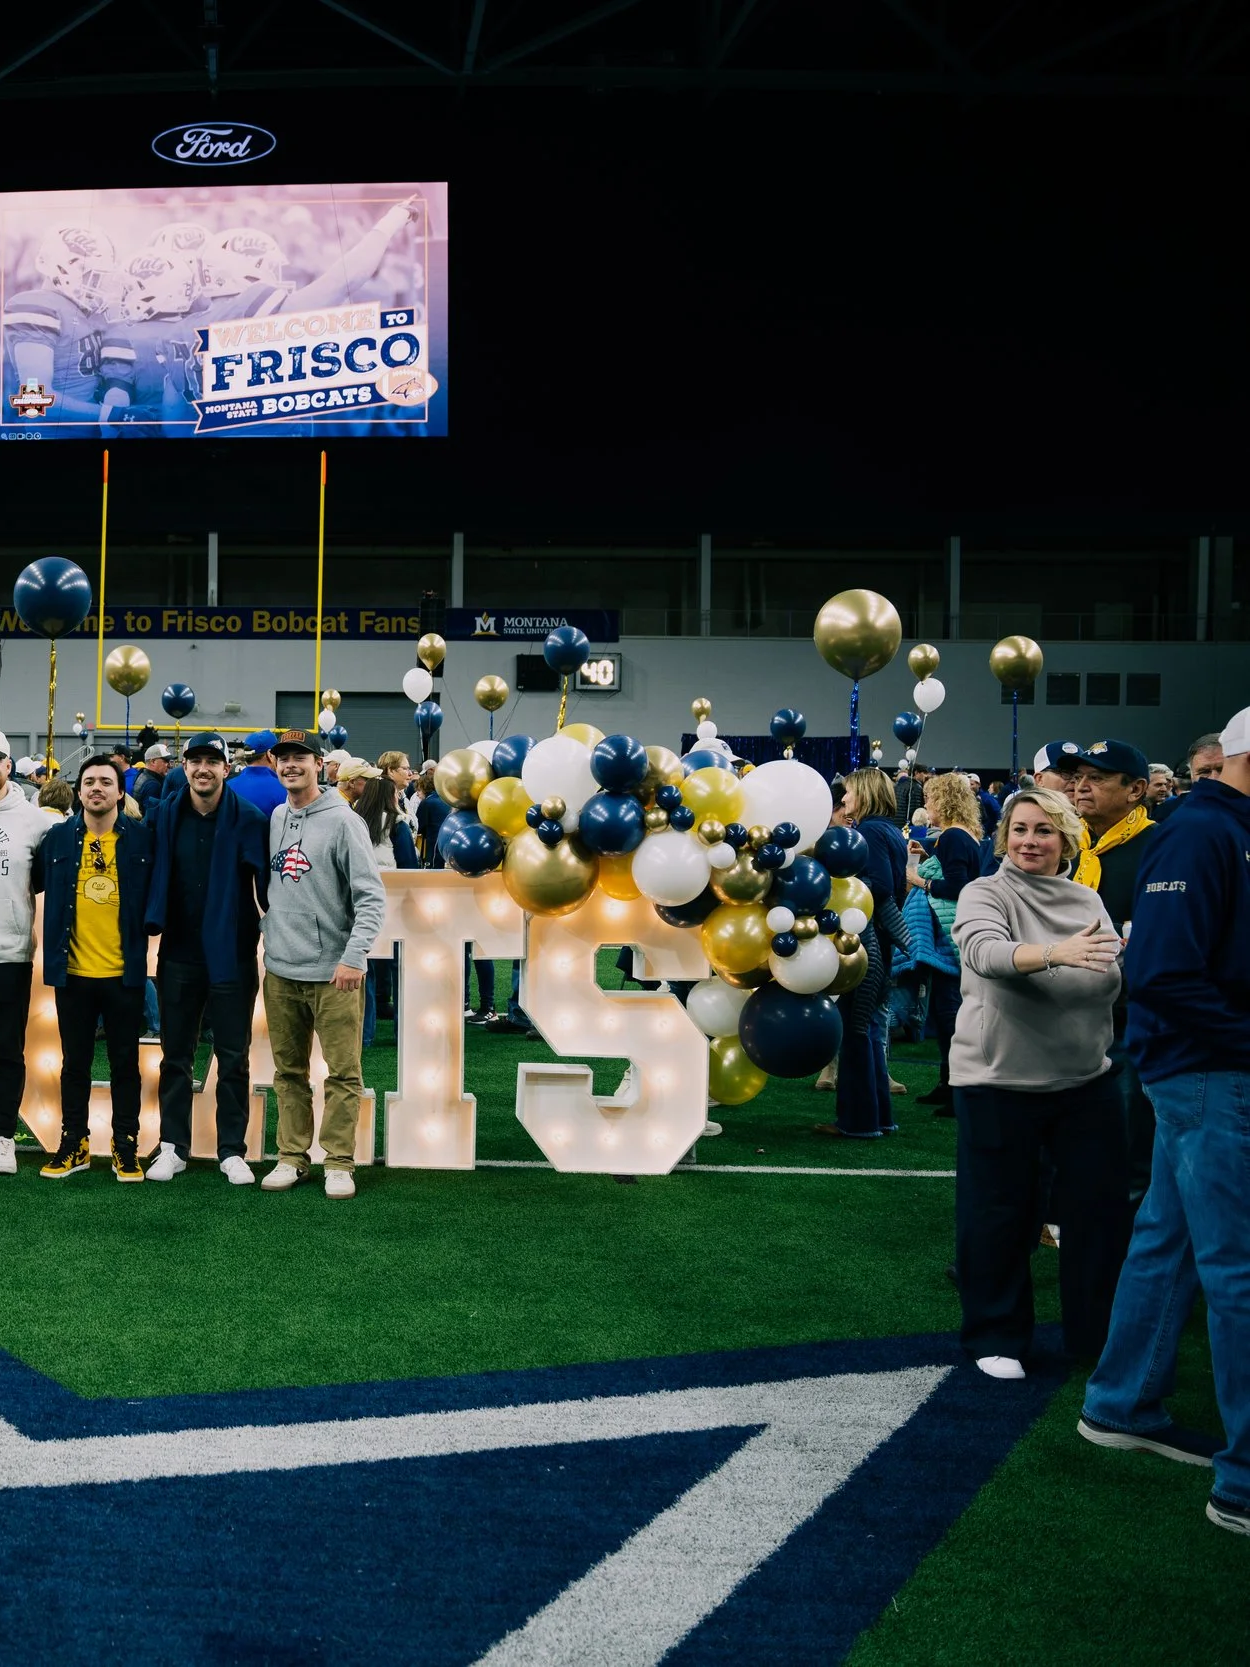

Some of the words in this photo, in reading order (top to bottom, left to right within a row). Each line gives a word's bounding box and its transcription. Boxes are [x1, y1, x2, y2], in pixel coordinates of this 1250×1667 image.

[175, 128, 252, 158] Ford
[213, 308, 375, 348] WELCOME
[386, 312, 408, 325] TO
[211, 332, 420, 392] FRISCO
[205, 401, 257, 414] MONTANA
[262, 387, 371, 415] BOBCATS
[226, 409, 257, 419] STATE
[0, 610, 114, 632] Weme
[125, 611, 151, 632] to
[162, 611, 242, 632] Frisco
[253, 610, 348, 633] Bobcat
[359, 611, 420, 633] Fans
[503, 617, 569, 628] MONTANA
[581, 660, 614, 685] 40
[1145, 881, 1187, 893] BOBCATS
